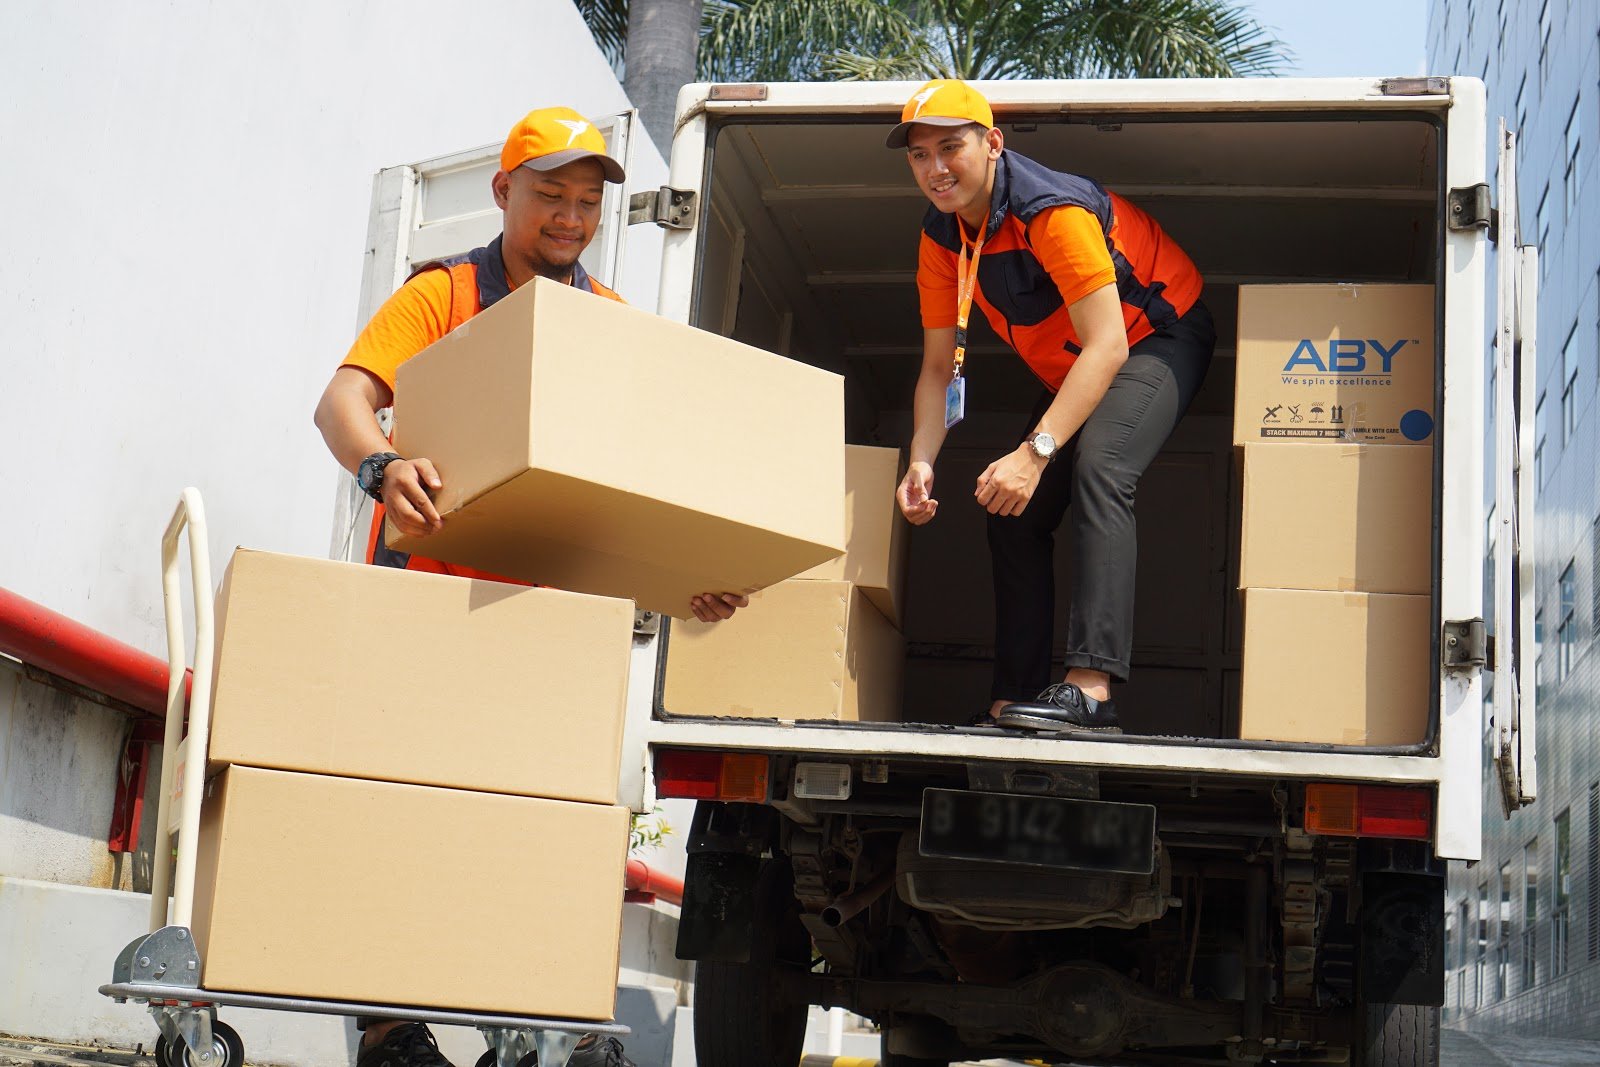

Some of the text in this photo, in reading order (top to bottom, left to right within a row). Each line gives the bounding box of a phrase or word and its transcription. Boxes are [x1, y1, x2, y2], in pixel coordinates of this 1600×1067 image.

[1282, 338, 1409, 373] ABY
[1282, 377, 1392, 387] We spin excellence
[1266, 428, 1286, 436] STACK
